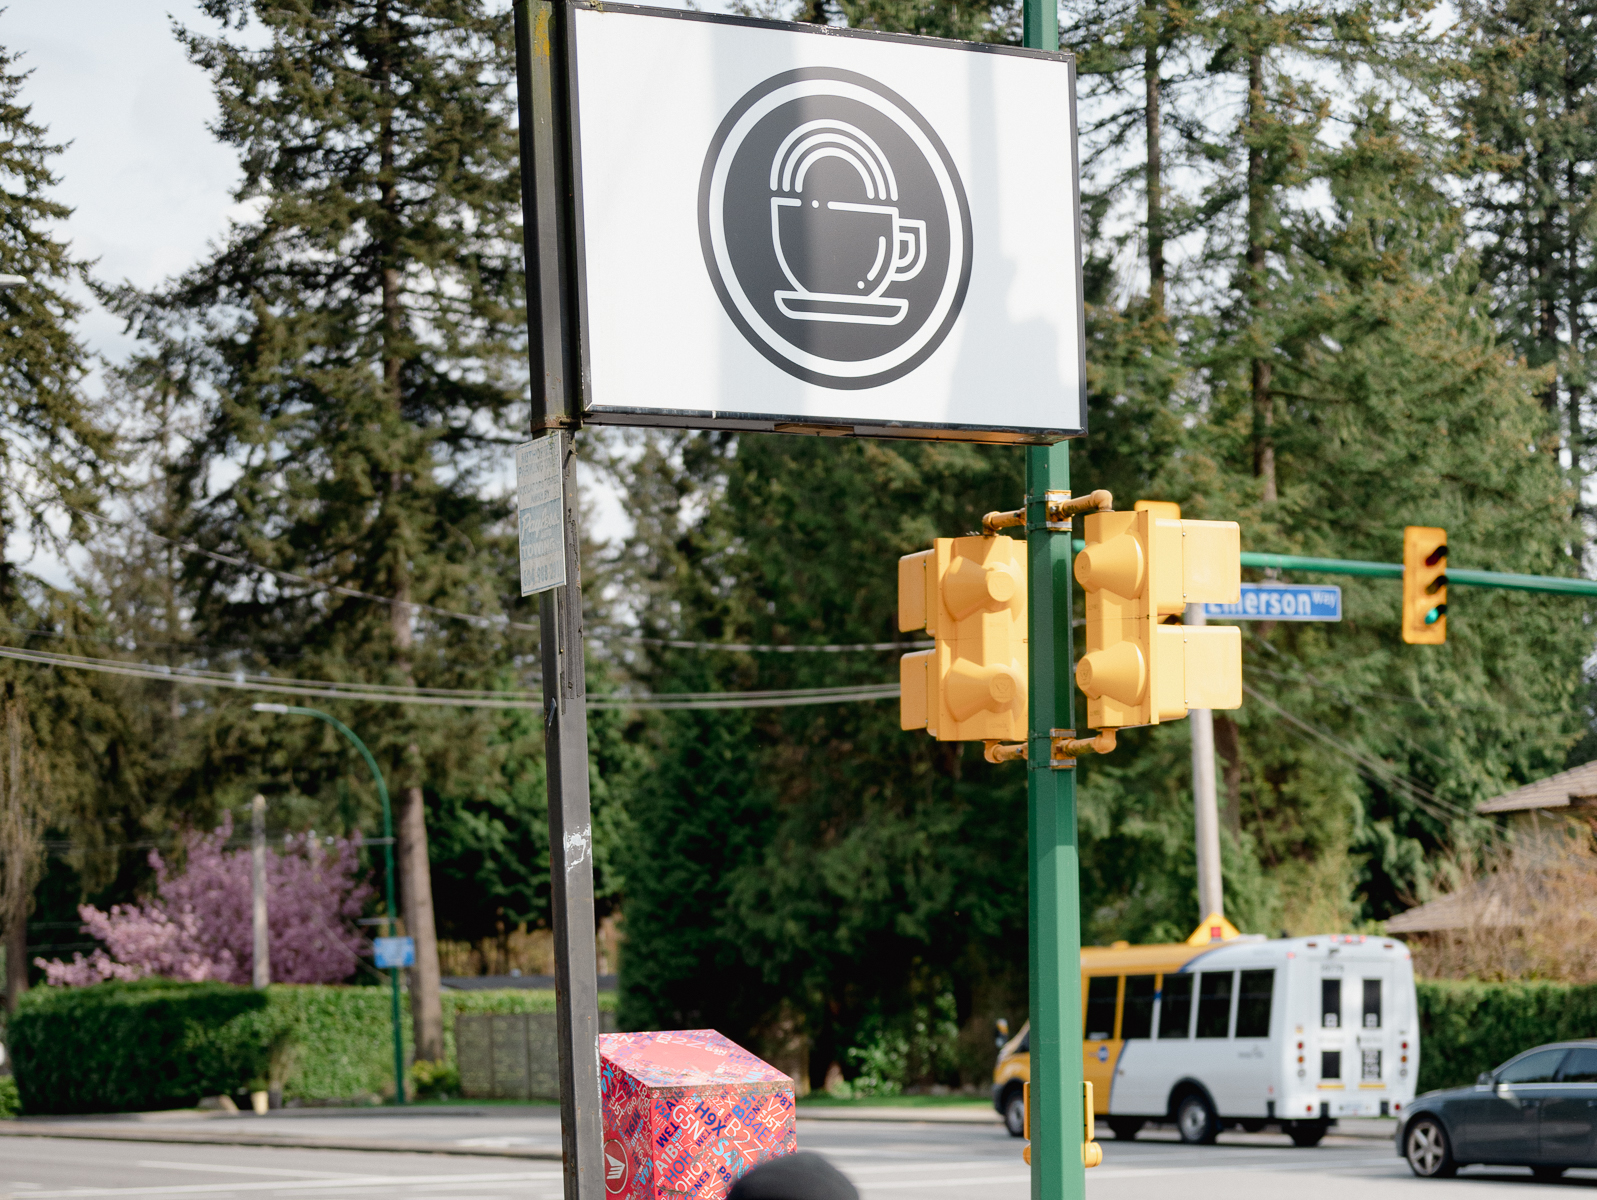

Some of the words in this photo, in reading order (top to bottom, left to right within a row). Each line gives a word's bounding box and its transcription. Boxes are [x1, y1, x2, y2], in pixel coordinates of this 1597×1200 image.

[522, 538, 556, 558] TOWING
[1312, 591, 1336, 608] Way
[656, 1033, 706, 1049] B2Z
[601, 1063, 614, 1094] K4
[654, 1100, 671, 1122] V5A
[682, 1096, 697, 1111] P8T
[767, 1096, 790, 1125] V7J
[774, 1092, 794, 1111] P8T
[624, 1108, 641, 1138] M9L
[653, 1114, 668, 1129] H1T
[672, 1104, 706, 1141] G5N
[694, 1100, 727, 1138] H9X
[742, 1110, 771, 1144] B4E
[762, 1114, 782, 1132] J5T
[656, 1121, 680, 1148] T3M
[671, 1128, 683, 1144] N5P
[695, 1129, 712, 1148] T3M
[723, 1117, 764, 1163] B2Z
[654, 1144, 679, 1175] A1B
[639, 1157, 654, 1185] K4A
[694, 1170, 711, 1191] E3N
